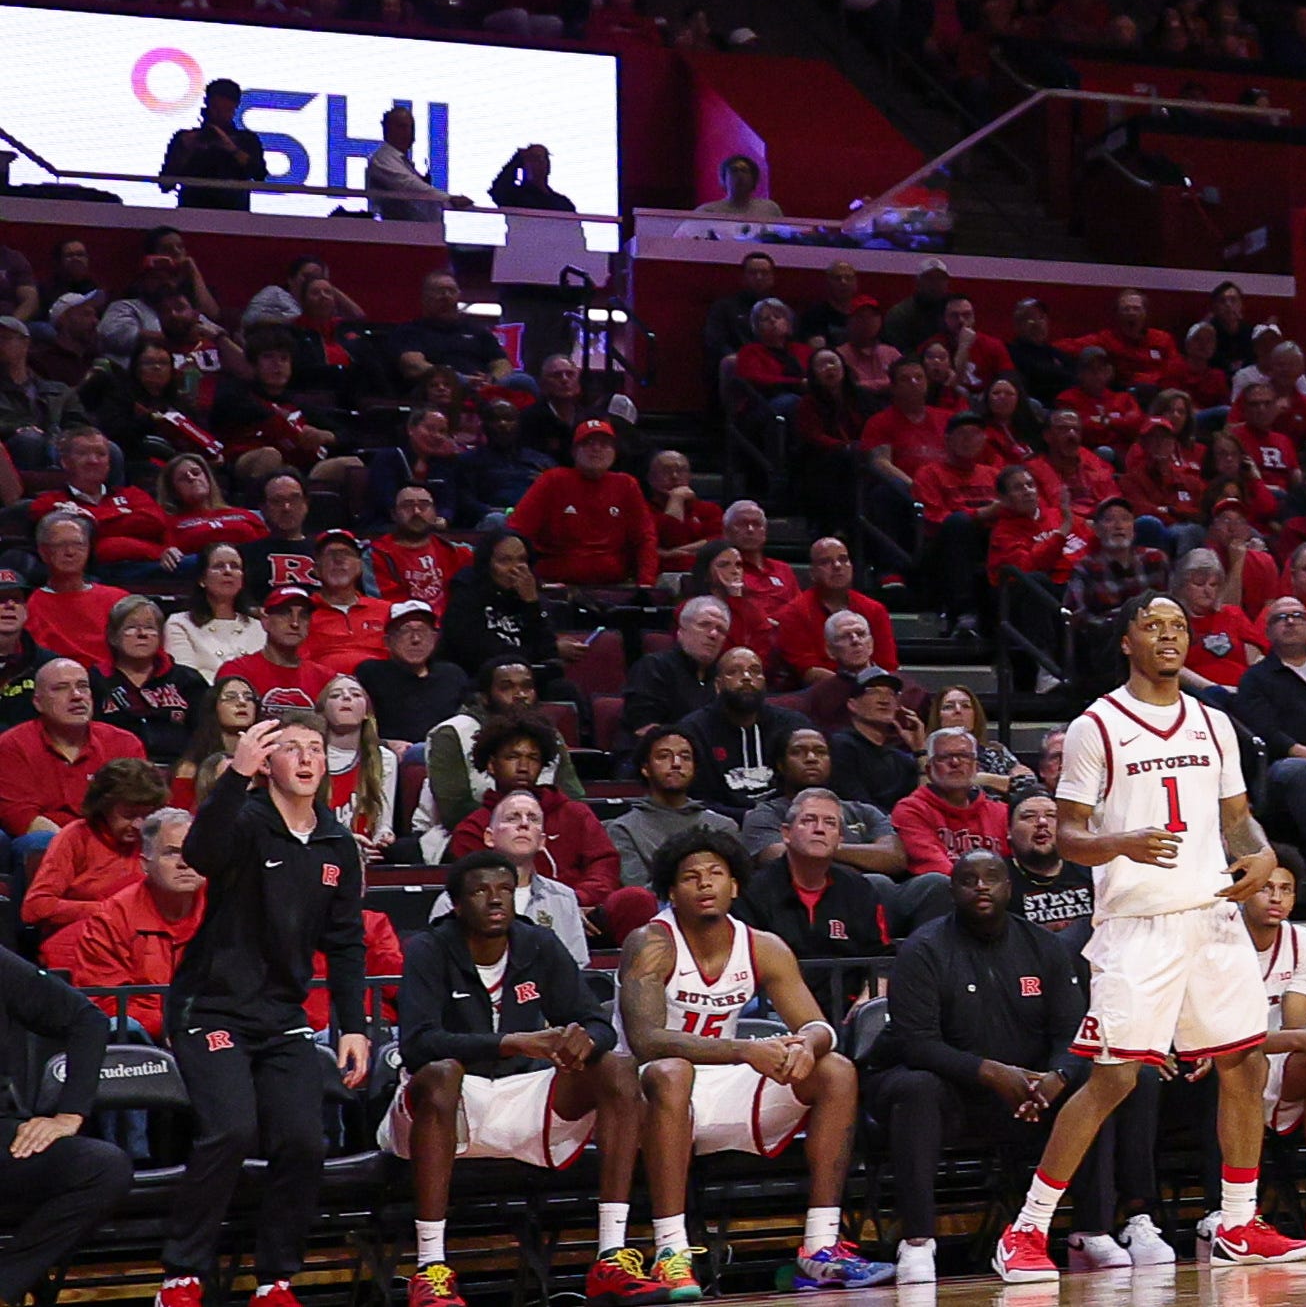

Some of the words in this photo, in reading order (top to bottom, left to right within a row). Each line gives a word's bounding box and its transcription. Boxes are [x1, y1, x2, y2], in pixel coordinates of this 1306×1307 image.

[266, 553, 322, 587] R
[1126, 754, 1211, 776] RUTGERS
[1161, 776, 1188, 834] 1
[321, 863, 341, 888] R
[513, 980, 541, 1005] R
[1018, 975, 1042, 997] R
[204, 1030, 235, 1053] R
[1080, 1015, 1101, 1043] R
[99, 1059, 169, 1079] rudential
